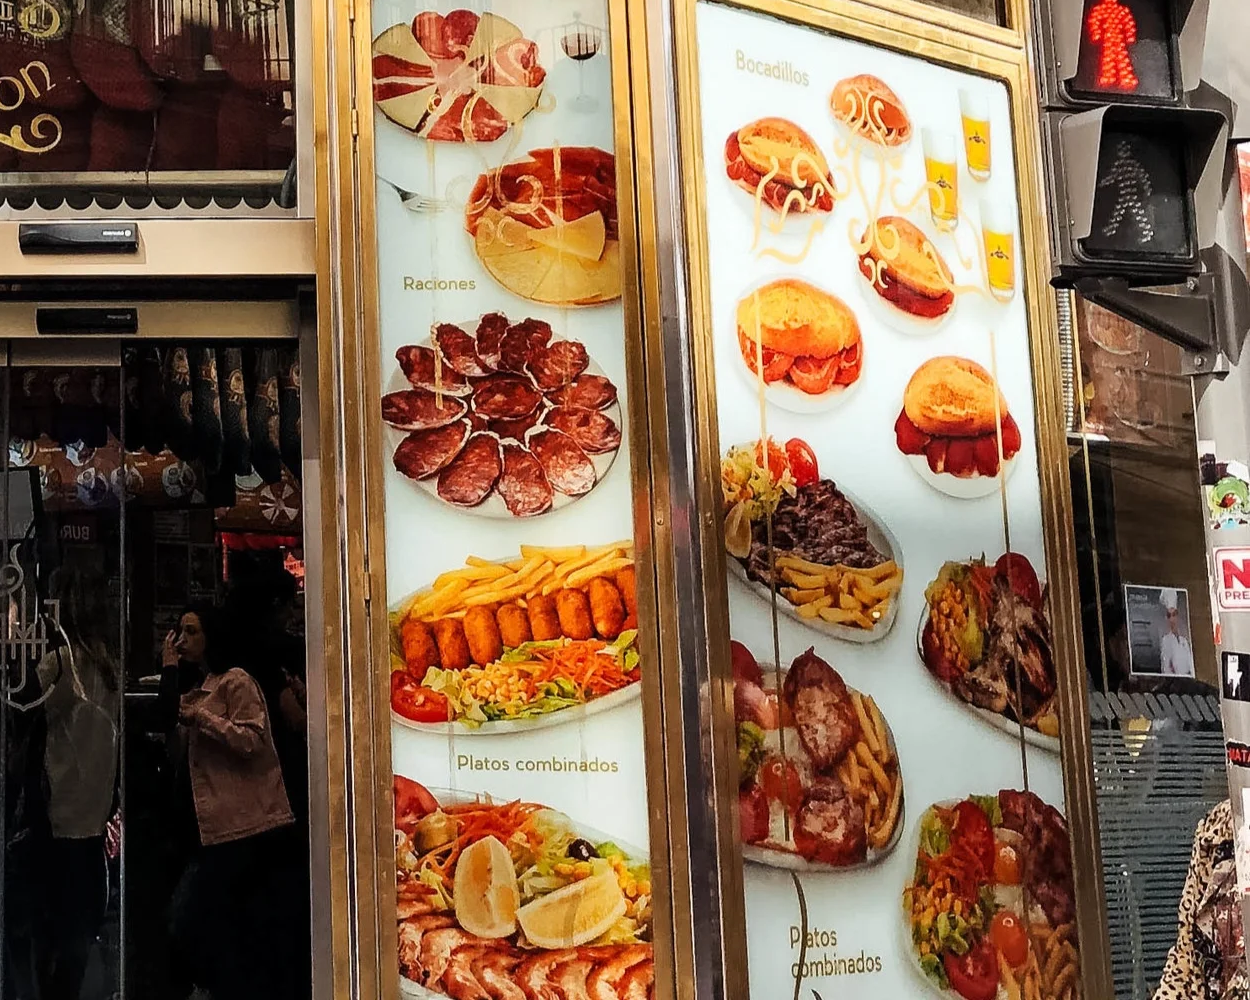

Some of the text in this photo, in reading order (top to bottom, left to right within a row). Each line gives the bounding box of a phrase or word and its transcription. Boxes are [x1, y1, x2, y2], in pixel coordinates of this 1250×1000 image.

[735, 48, 810, 87] Bocadillos
[403, 276, 477, 291] Raciones
[1225, 591, 1250, 600] PRE
[457, 755, 619, 773] Platos combinados
[791, 949, 883, 979] combinados
